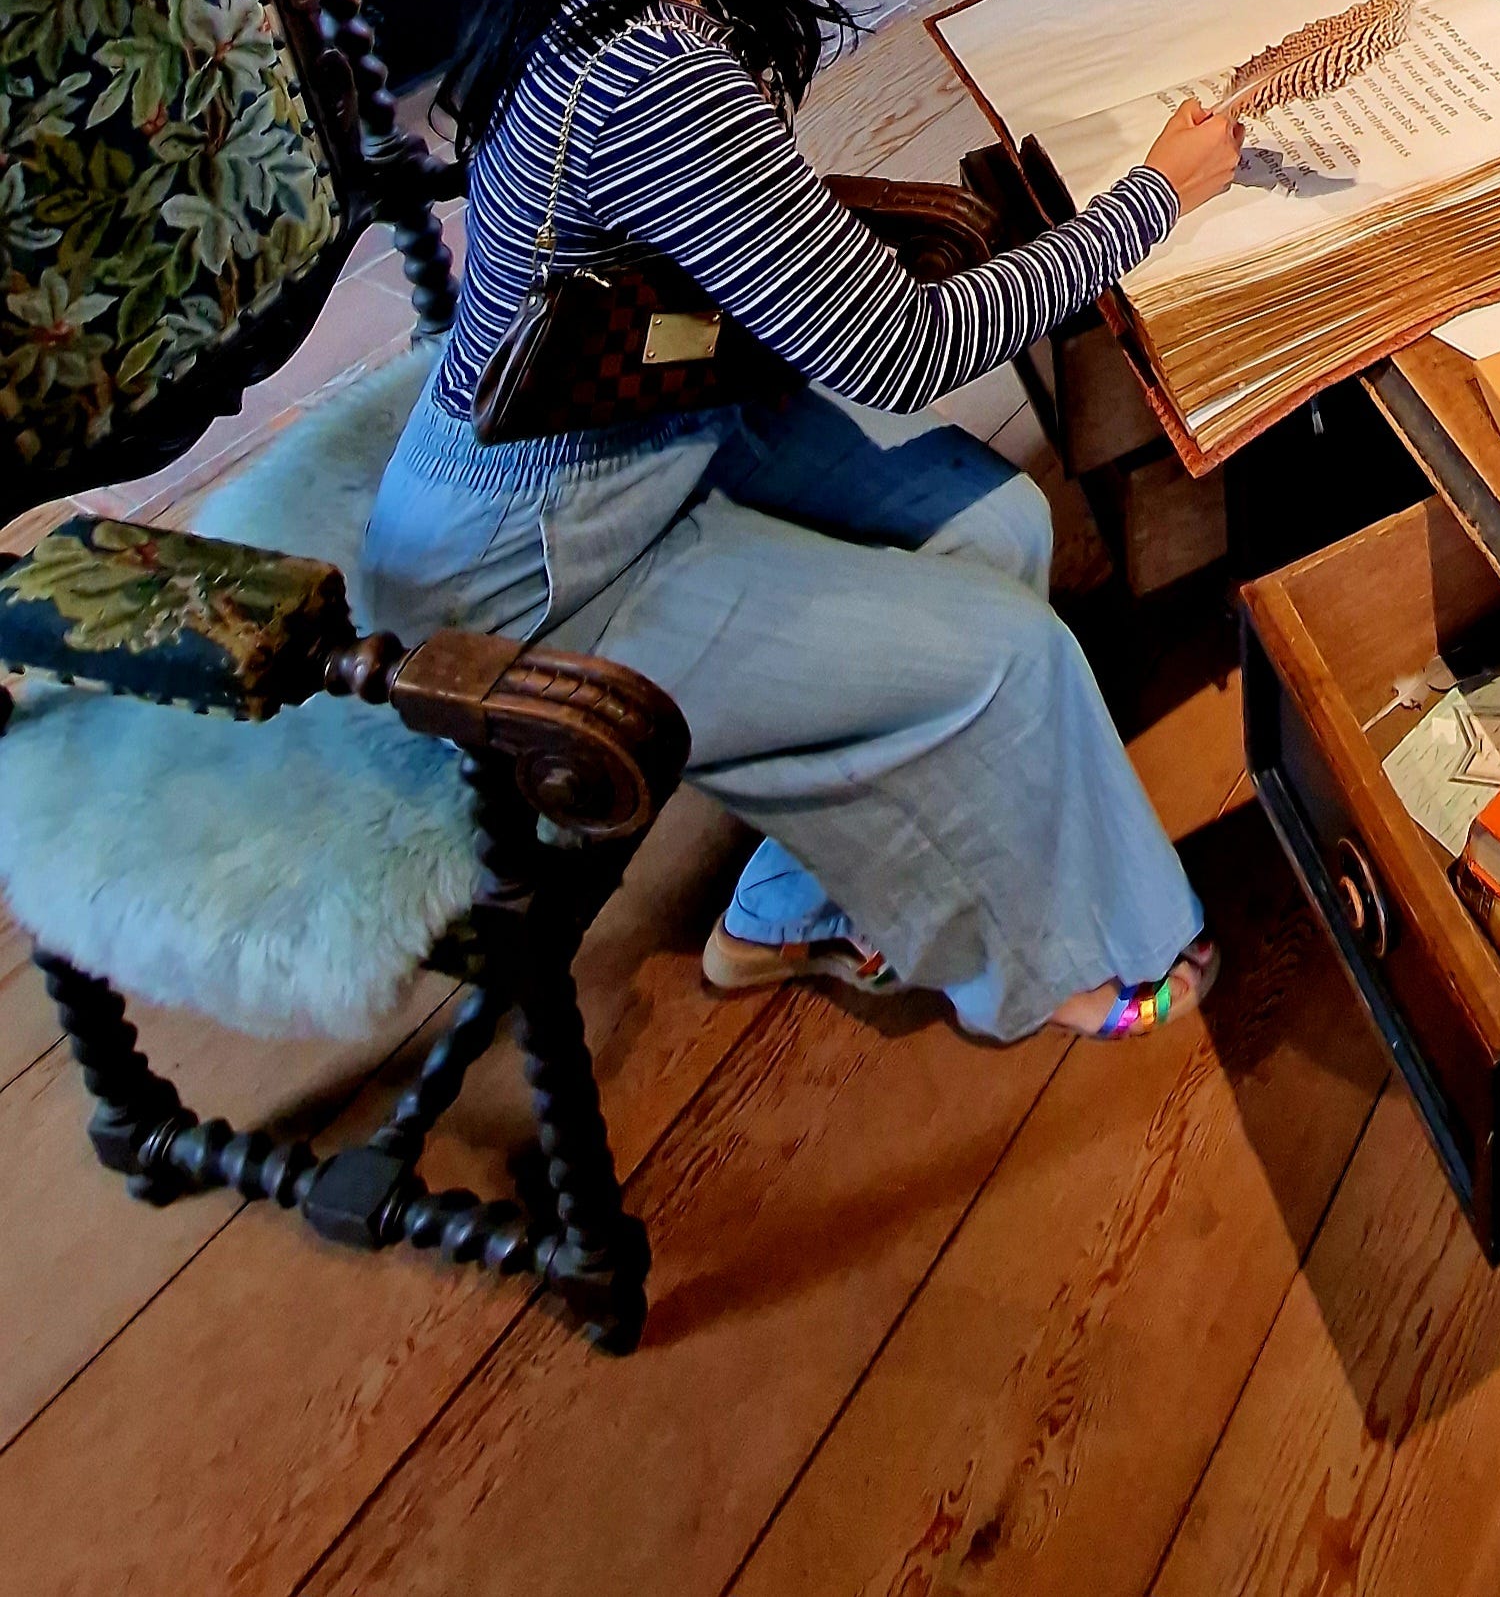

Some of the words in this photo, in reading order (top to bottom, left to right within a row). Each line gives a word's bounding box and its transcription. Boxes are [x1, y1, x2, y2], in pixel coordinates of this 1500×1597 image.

[1433, 41, 1469, 73] eeuwige
[1424, 85, 1443, 103] van
[1443, 78, 1466, 97] naar
[1463, 96, 1493, 122] buiten
[1331, 100, 1364, 135] mooiste
[1345, 87, 1411, 157] mensenheugenis
[1289, 117, 1336, 170] edelmetalen
